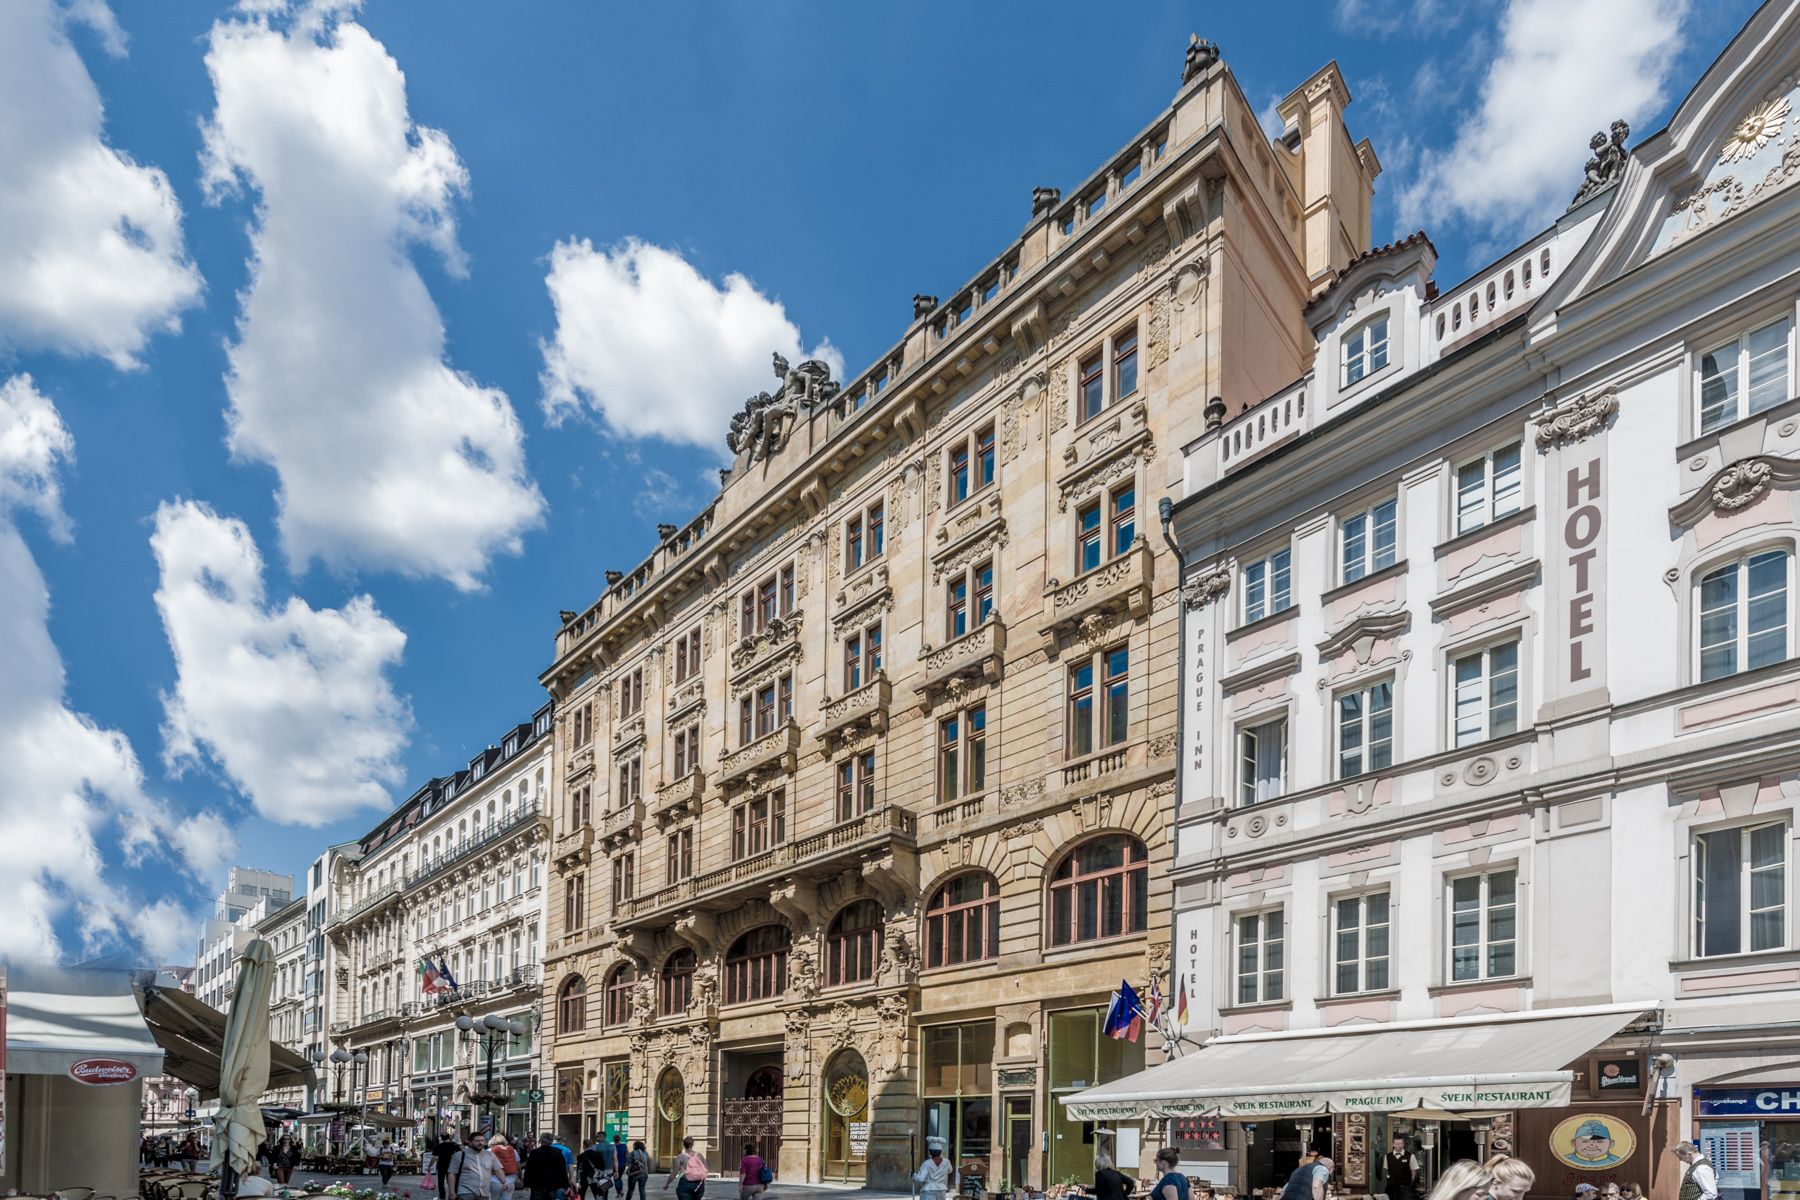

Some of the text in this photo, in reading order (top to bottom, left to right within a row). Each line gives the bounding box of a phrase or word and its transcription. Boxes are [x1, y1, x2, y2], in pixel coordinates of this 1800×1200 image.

[1564, 457, 1602, 682] HOTEL
[1194, 628, 1204, 771] PRAGUE INN
[1190, 929, 1198, 999] HOTEL
[74, 1064, 132, 1075] Budweiser
[1345, 1096, 1403, 1106] PRAGUE INN
[1441, 1091, 1552, 1102] ŠVEJK RESTAURANT
[1755, 1092, 1800, 1110] CH
[1097, 1106, 1138, 1114] RESTAURANT
[1162, 1103, 1205, 1112] PRAGUE INN
[1233, 1099, 1312, 1110] ŠVEJK RESTAURANT
